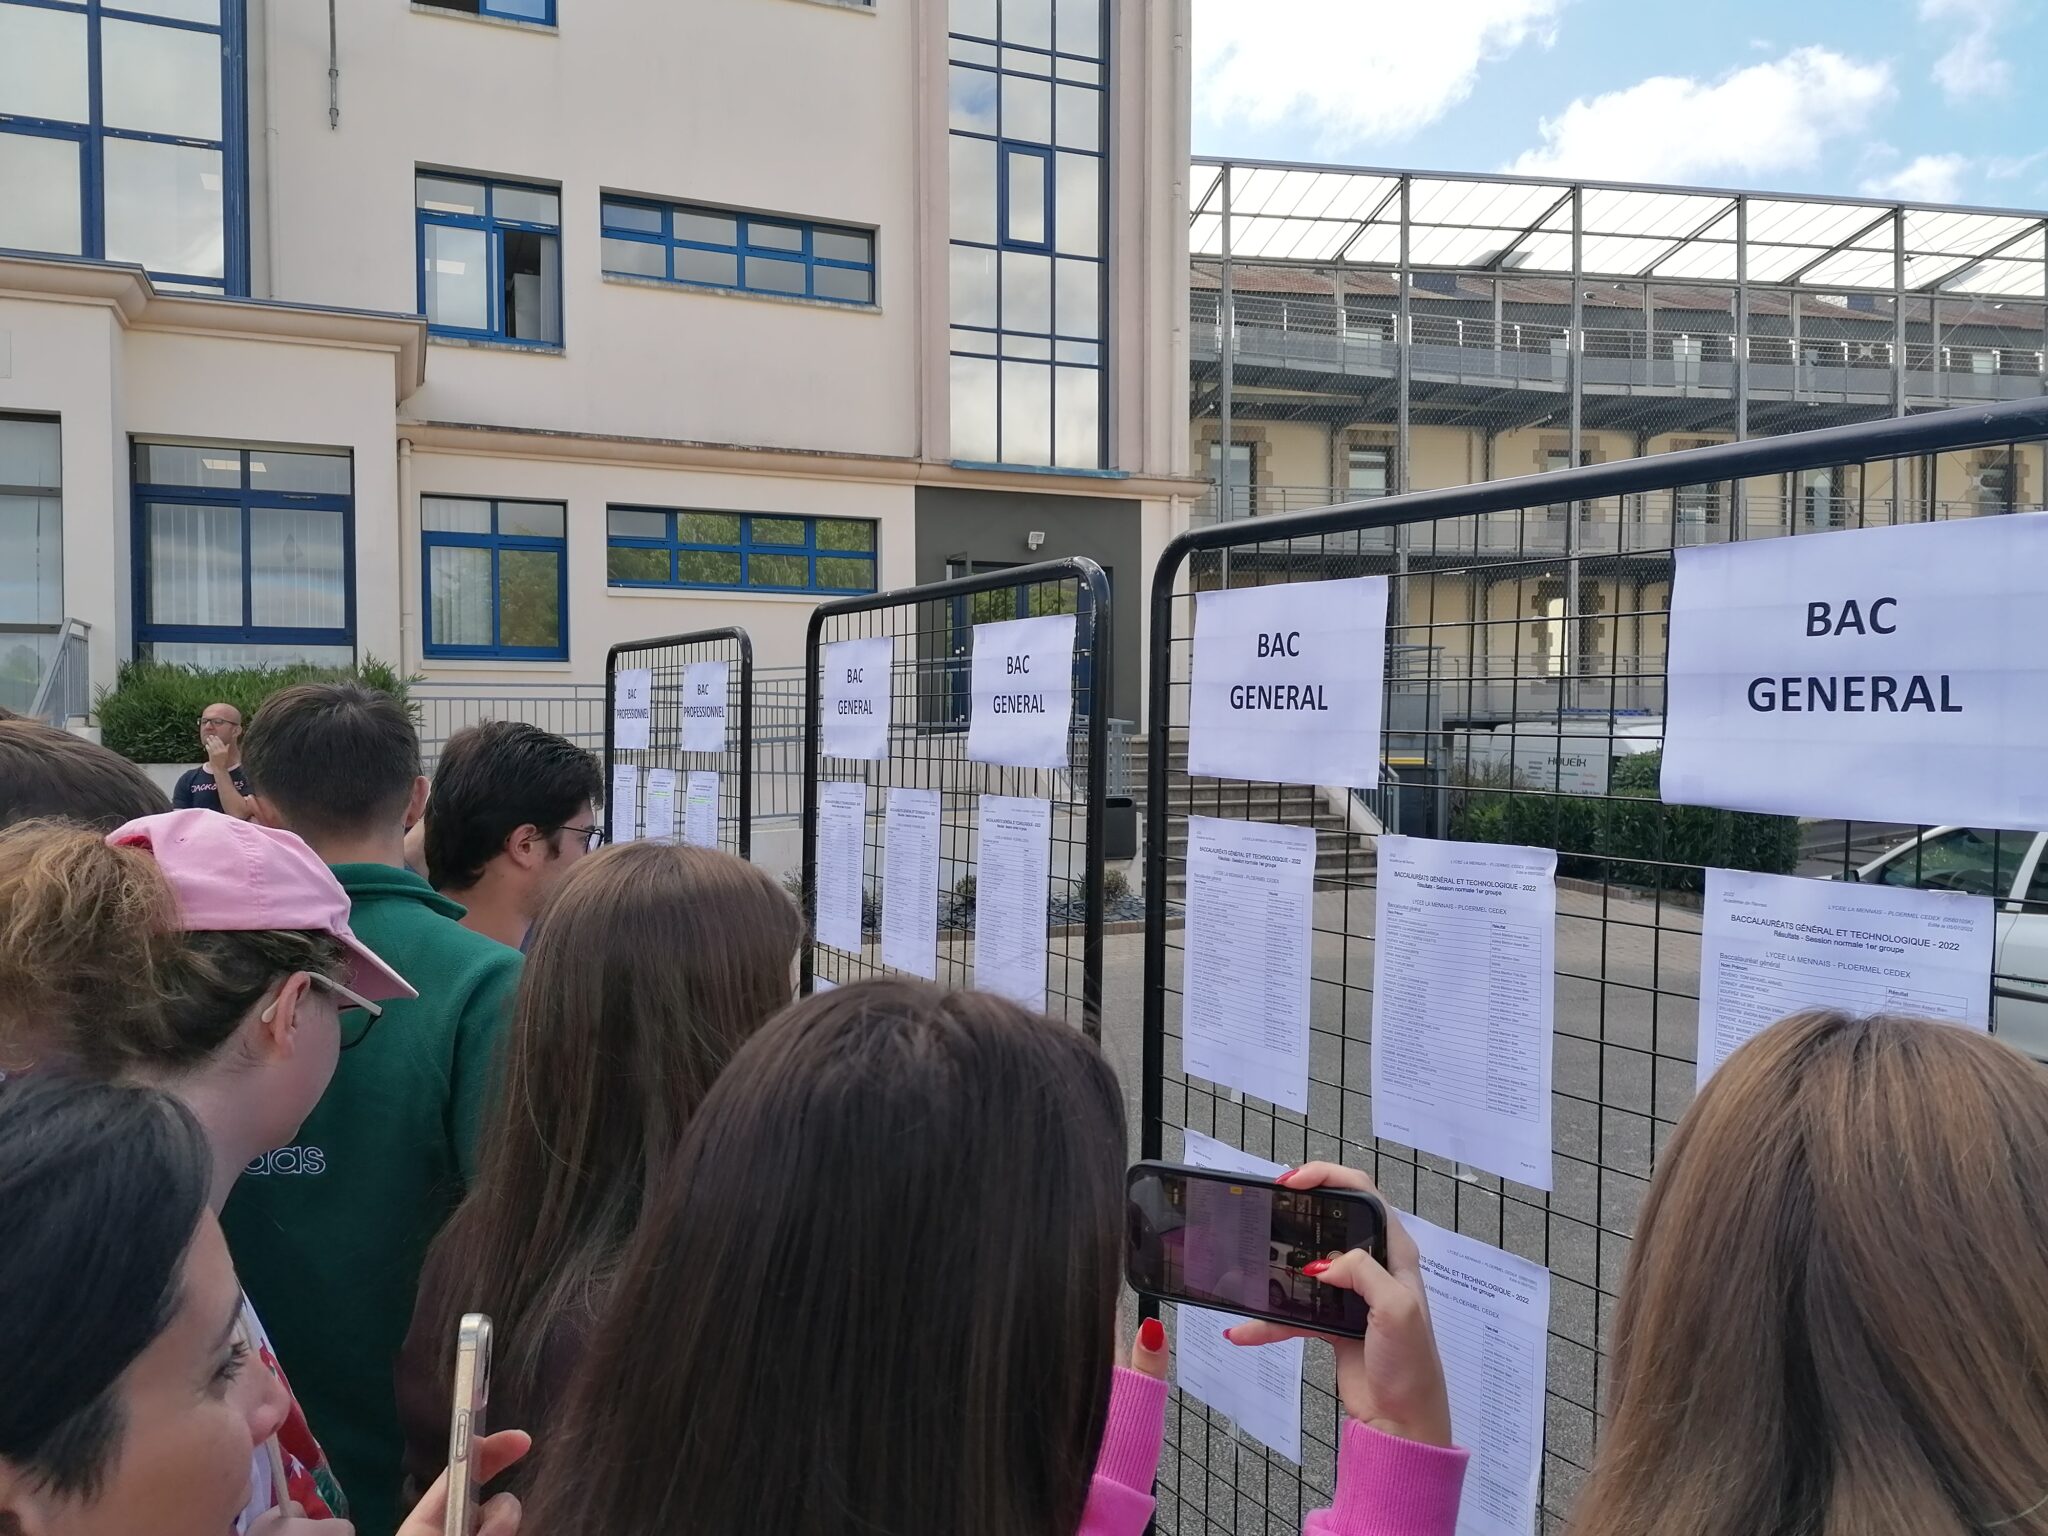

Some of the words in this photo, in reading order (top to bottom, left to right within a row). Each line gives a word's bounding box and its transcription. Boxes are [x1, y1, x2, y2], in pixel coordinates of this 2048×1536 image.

[1807, 597, 1897, 637] BAC
[1258, 632, 1300, 658] BAC
[1007, 655, 1030, 675] BAC
[847, 668, 863, 684] BAC
[628, 688, 637, 700] BAC
[697, 683, 710, 696] BAC
[1748, 675, 1963, 713] GENERAL
[993, 693, 1046, 714] GENERAL
[1231, 686, 1329, 711] GENERAL
[617, 708, 649, 719] PROFESSIONNEL
[683, 705, 725, 718] PROFESSIONNEL
[838, 699, 873, 715] GENERAL
[1430, 874, 1456, 885] GÉNÉRAL
[1466, 879, 1519, 890] TECHNOLOGIQUE
[1458, 904, 1487, 913] PLOERMEL
[1856, 907, 1883, 915] MENNAIS
[1888, 911, 1920, 920] PLOERMEL
[1731, 914, 1794, 930] BACCALAURÉATS
[1795, 923, 1835, 936] GÉNÉRAL
[1836, 929, 1848, 938] ET
[1849, 930, 1931, 948] TECHNOLOGIQUE
[1938, 941, 1960, 951] 2022
[1774, 930, 1800, 941] Résultats
[1805, 935, 1832, 945] Session
[1833, 940, 1863, 949] normale
[1879, 945, 1905, 955] groupe
[1759, 959, 1781, 969] général
[1766, 951, 1787, 961] LYCEE
[1787, 954, 1796, 962] LA
[1796, 956, 1831, 968] MENNAIS
[1837, 962, 1882, 975] PLOERMEL
[1883, 968, 1911, 978] CEDEX
[1427, 1259, 1451, 1275] GÉNÉRAL
[1460, 1272, 1511, 1298] TECHNOLOGIQUE
[1515, 1293, 1530, 1305] 2022
[1479, 1288, 1496, 1299] groupe
